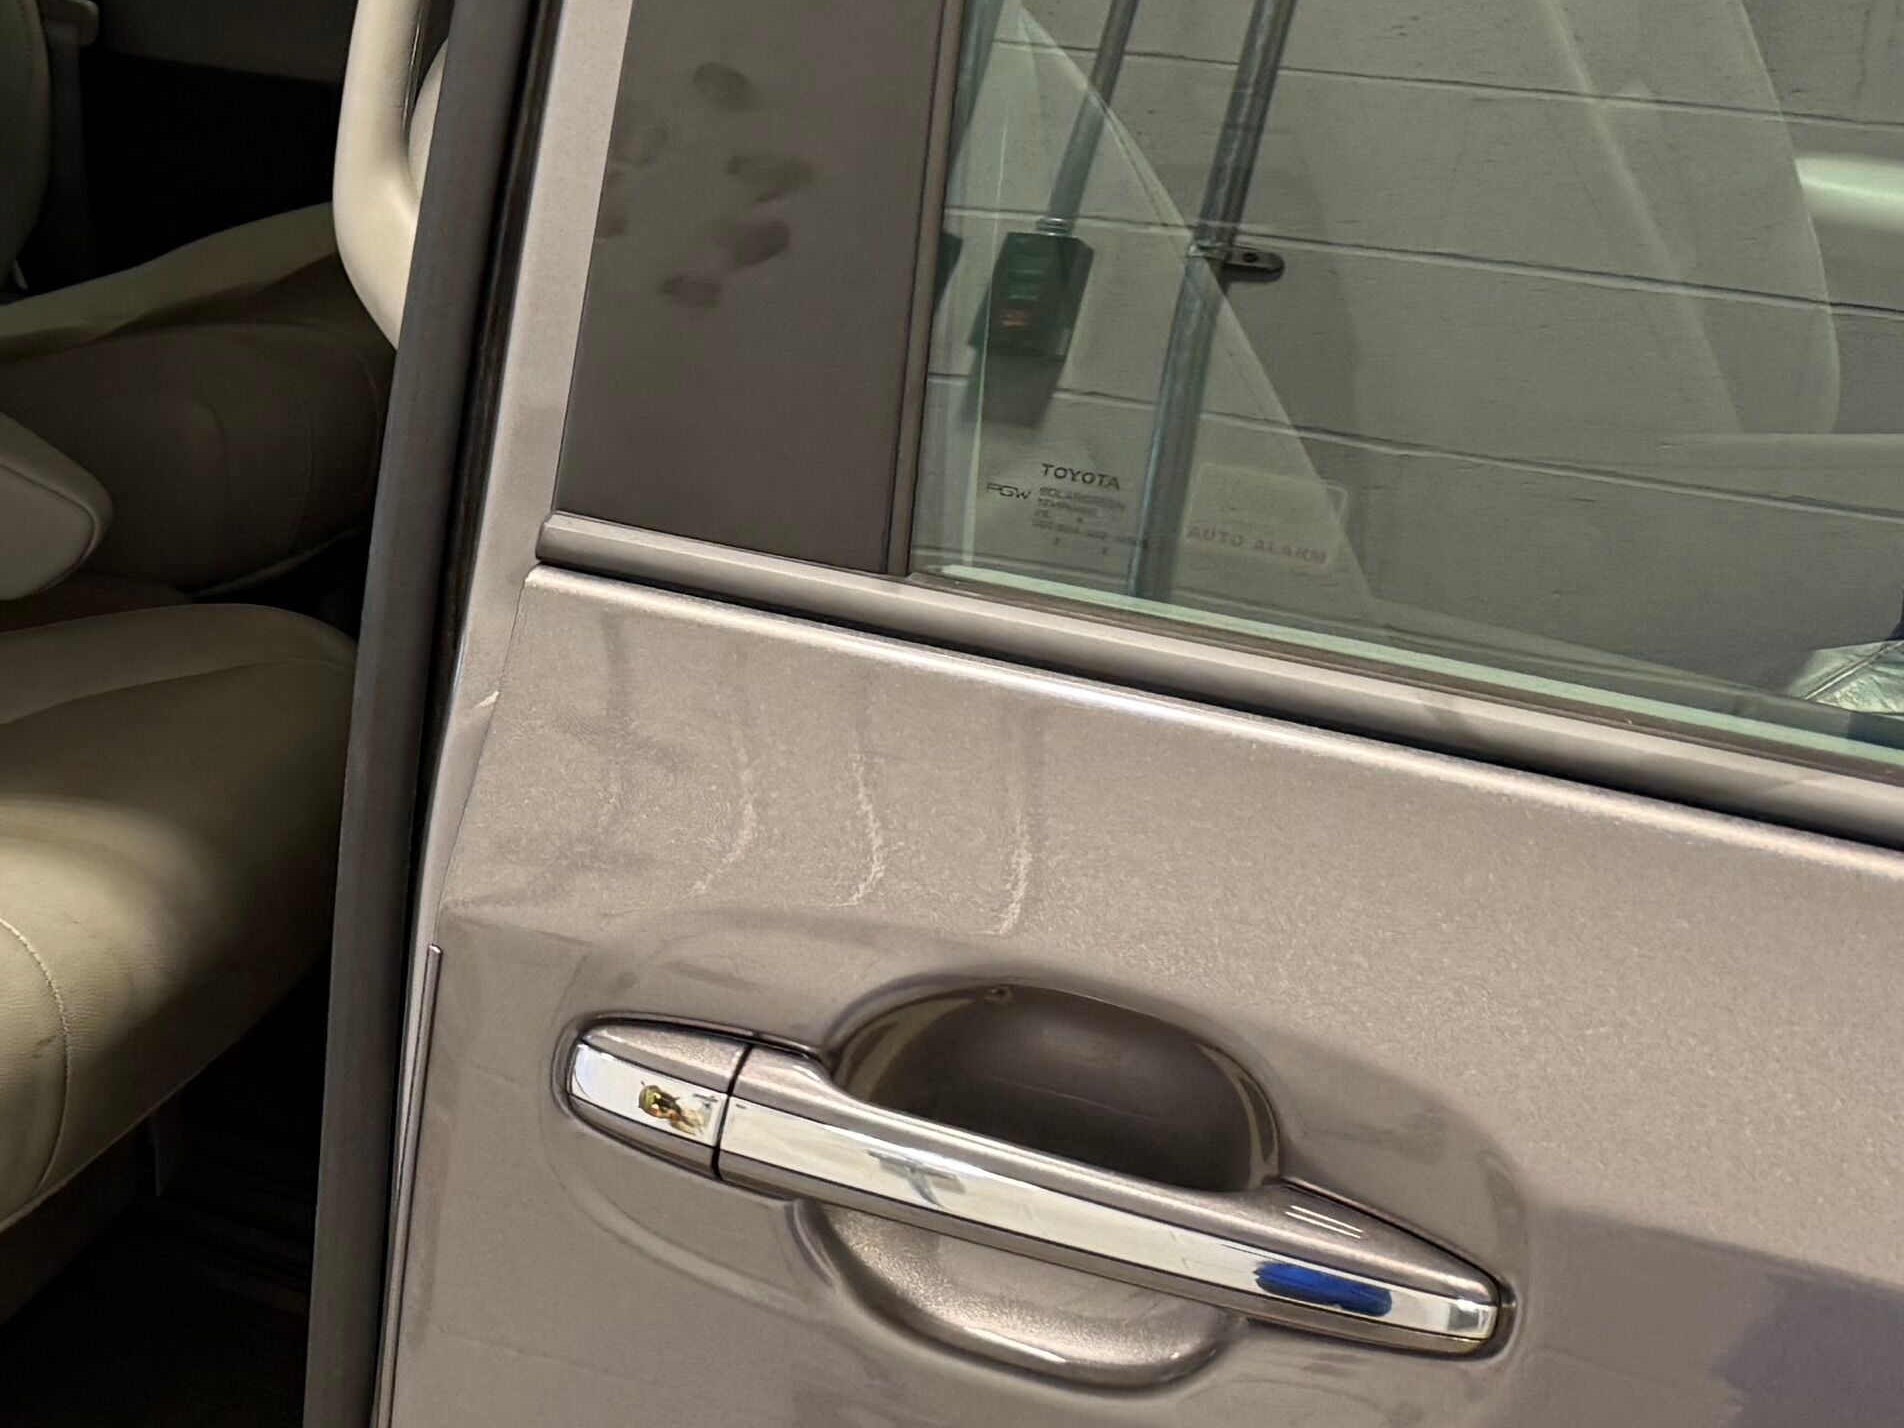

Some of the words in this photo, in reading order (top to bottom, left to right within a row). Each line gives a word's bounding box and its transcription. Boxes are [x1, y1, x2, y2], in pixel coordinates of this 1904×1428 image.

[1041, 462, 1121, 491] TOYOTA
[986, 482, 1032, 500] PGW
[1186, 525, 1245, 548] AUTO
